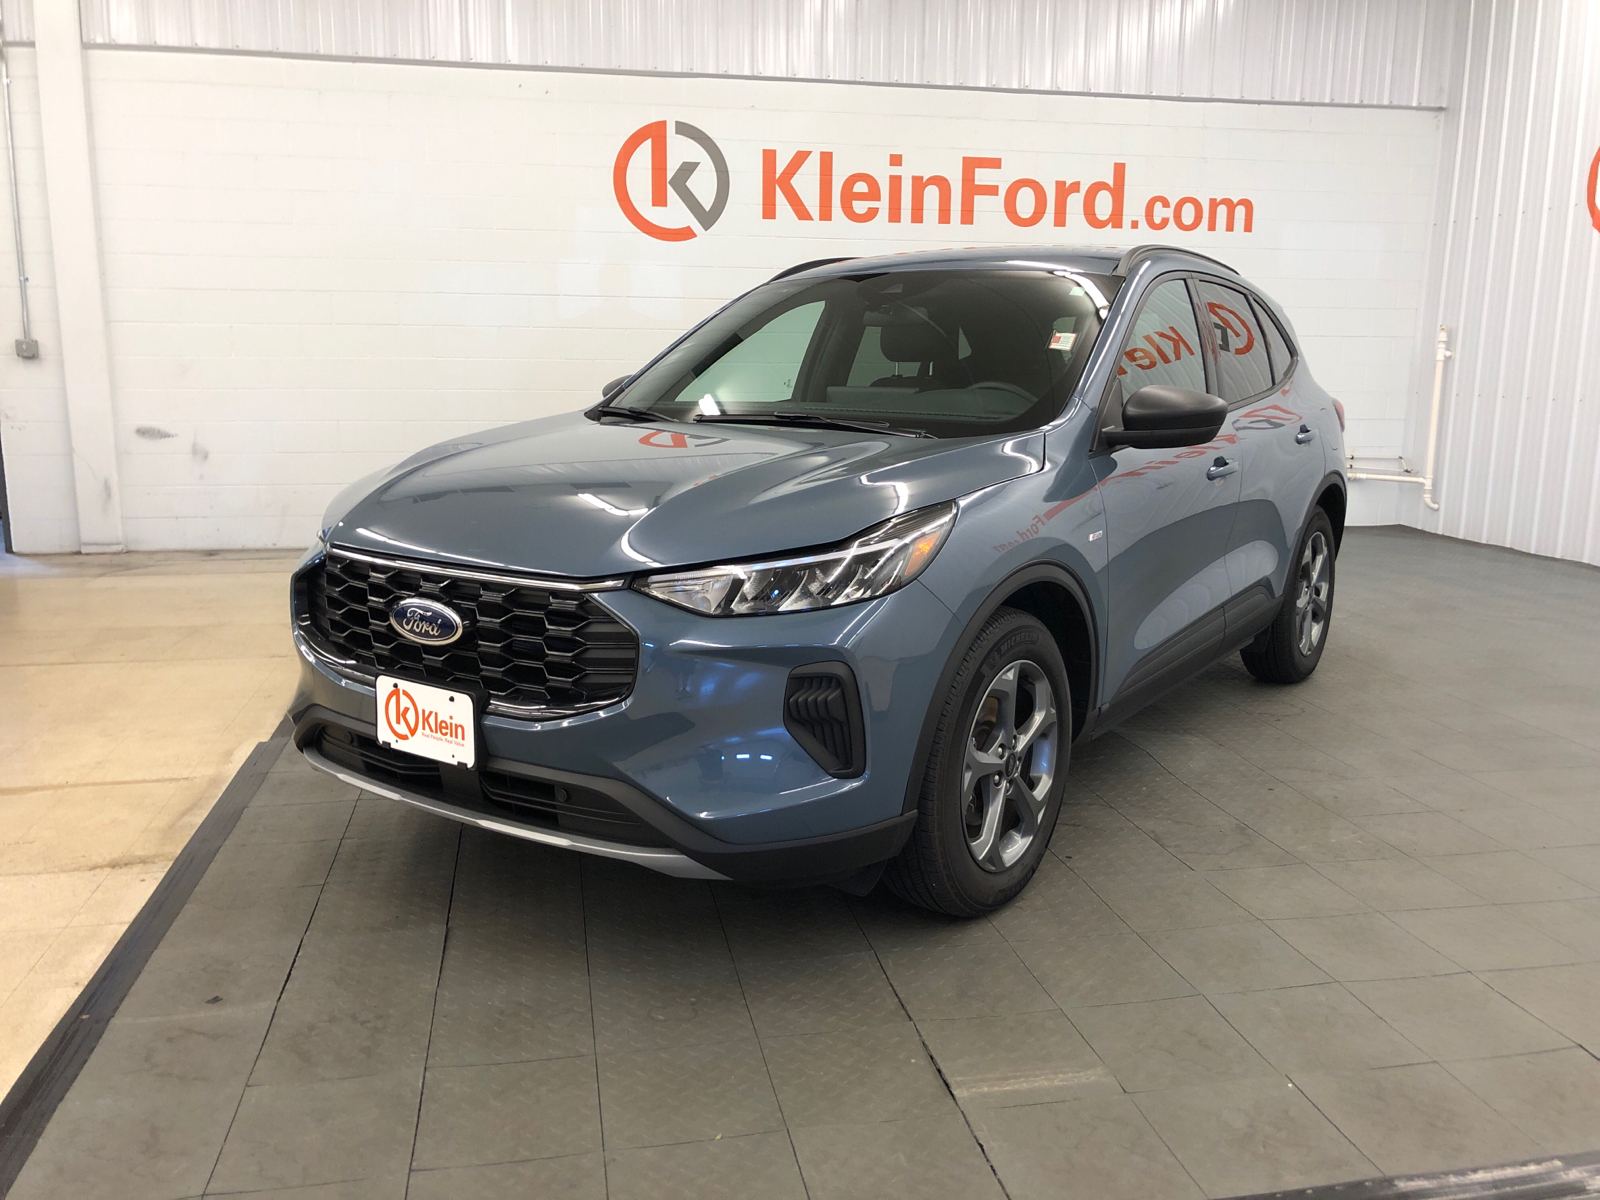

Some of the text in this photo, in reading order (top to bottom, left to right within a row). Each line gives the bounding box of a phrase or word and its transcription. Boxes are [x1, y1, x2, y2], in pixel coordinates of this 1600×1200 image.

[761, 148, 1254, 233] KleinFord.com
[402, 607, 442, 636] Ford
[421, 708, 466, 741] Klein
